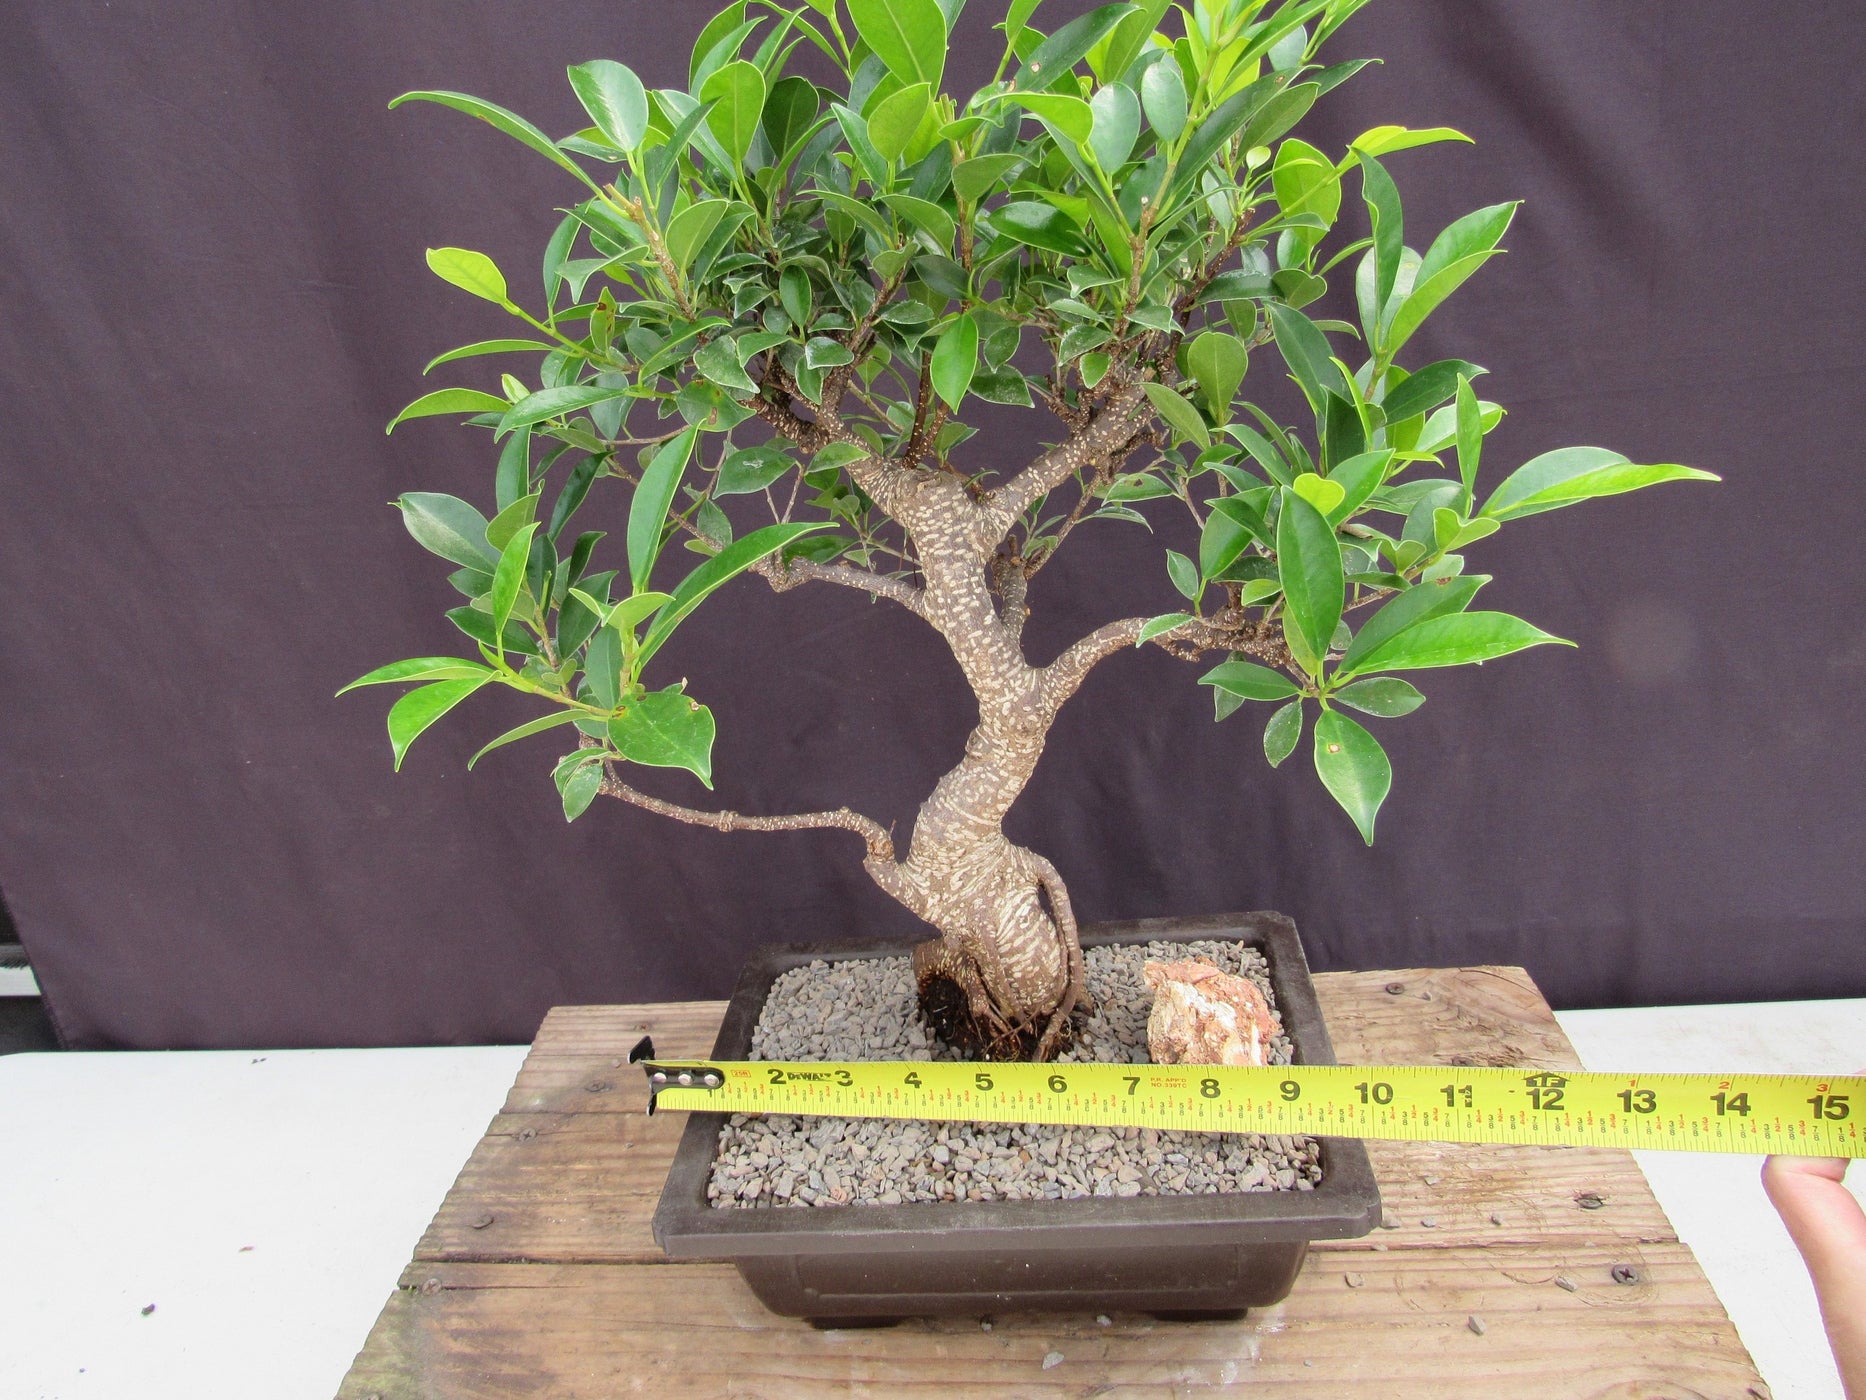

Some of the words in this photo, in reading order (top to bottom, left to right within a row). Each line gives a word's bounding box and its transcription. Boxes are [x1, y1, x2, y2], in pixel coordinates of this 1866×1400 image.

[767, 1069, 787, 1085] 2
[834, 1070, 853, 1087] 3
[904, 1072, 922, 1089] 4
[975, 1073, 994, 1091] 5
[1047, 1075, 1068, 1093] 6
[1122, 1076, 1141, 1096] 7
[1718, 1081, 1730, 1089] 2
[1200, 1078, 1221, 1099] 8
[1280, 1080, 1301, 1101] 9
[1354, 1082, 1394, 1105] 10
[1440, 1084, 1473, 1108] 11
[1816, 1084, 1828, 1092] 3
[1526, 1088, 1565, 1110] 12
[1617, 1089, 1657, 1114] 13
[1710, 1092, 1751, 1116] 14
[1807, 1095, 1850, 1120] 15
